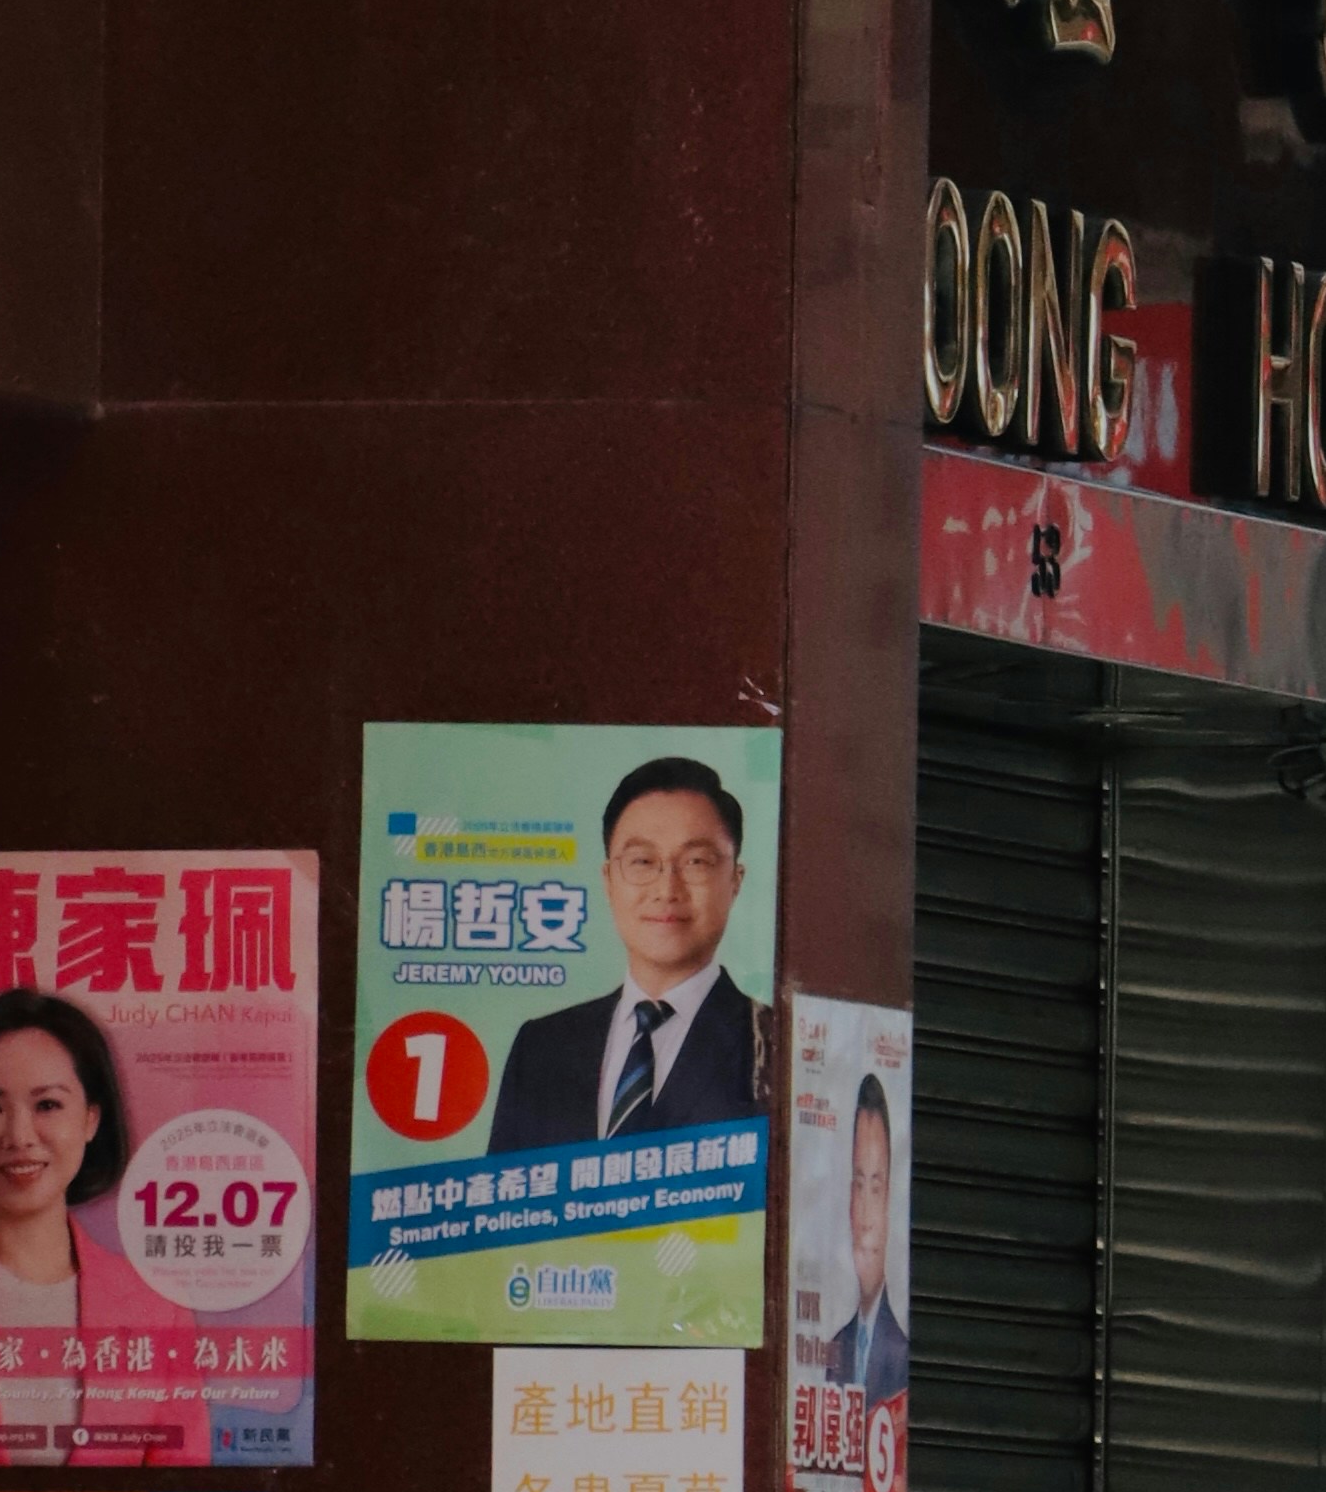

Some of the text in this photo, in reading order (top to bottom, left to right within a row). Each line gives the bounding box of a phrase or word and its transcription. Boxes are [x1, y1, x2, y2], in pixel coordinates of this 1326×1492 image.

[924, 177, 1137, 462] OONG
[381, 879, 588, 951] 楊哲安
[395, 963, 566, 986] JEREMY YOUNG
[108, 1005, 158, 1027] Judy
[166, 1005, 234, 1023] CHAN
[405, 1033, 447, 1122] 1
[135, 1181, 297, 1227] 12.07
[371, 1131, 759, 1222] 燃點中產希望 開創發展新機
[389, 1181, 745, 1246] Smarter Policies, Stronger Economy
[145, 1233, 283, 1258] 請投我一票
[511, 1381, 730, 1436] 產地直銷
[876, 1421, 889, 1484] 5
